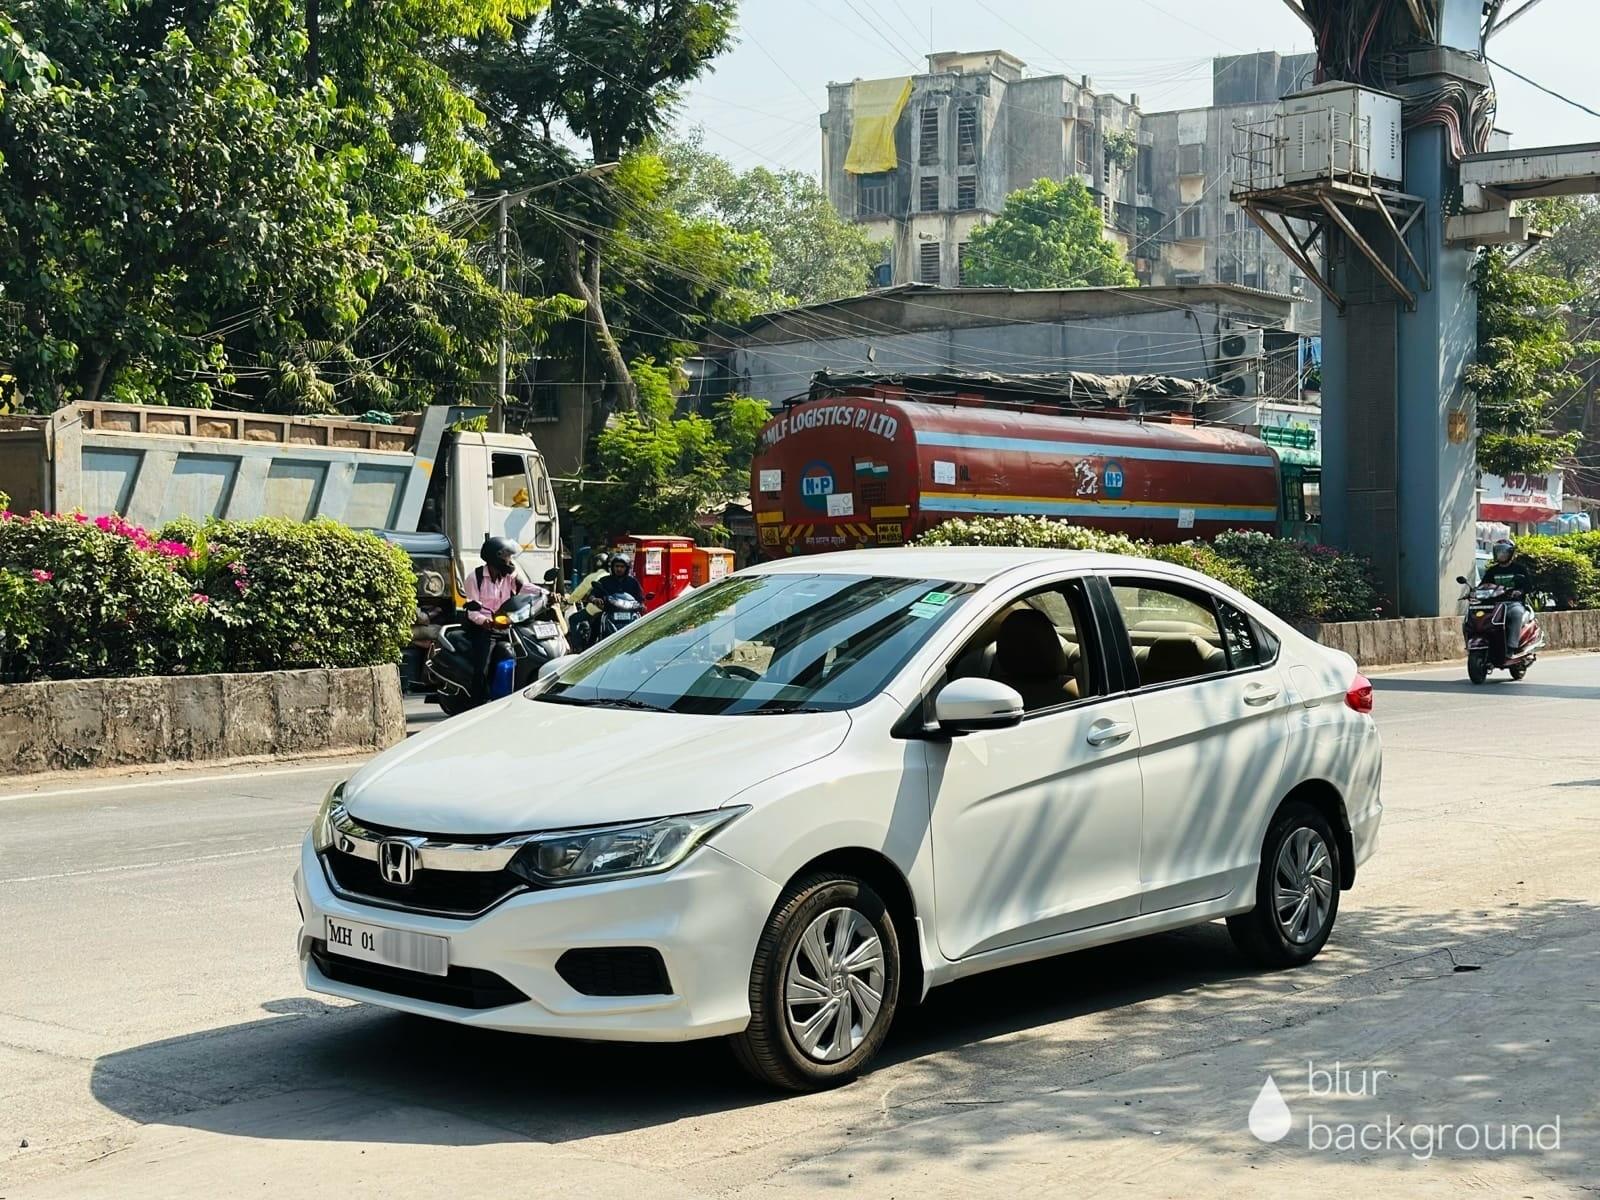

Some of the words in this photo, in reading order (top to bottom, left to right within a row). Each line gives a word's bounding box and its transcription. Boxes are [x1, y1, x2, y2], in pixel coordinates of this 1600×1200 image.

[790, 405, 854, 434] LOGISTICS
[868, 412, 898, 442] LTD.
[329, 925, 353, 946] MH
[361, 931, 376, 951] 01
